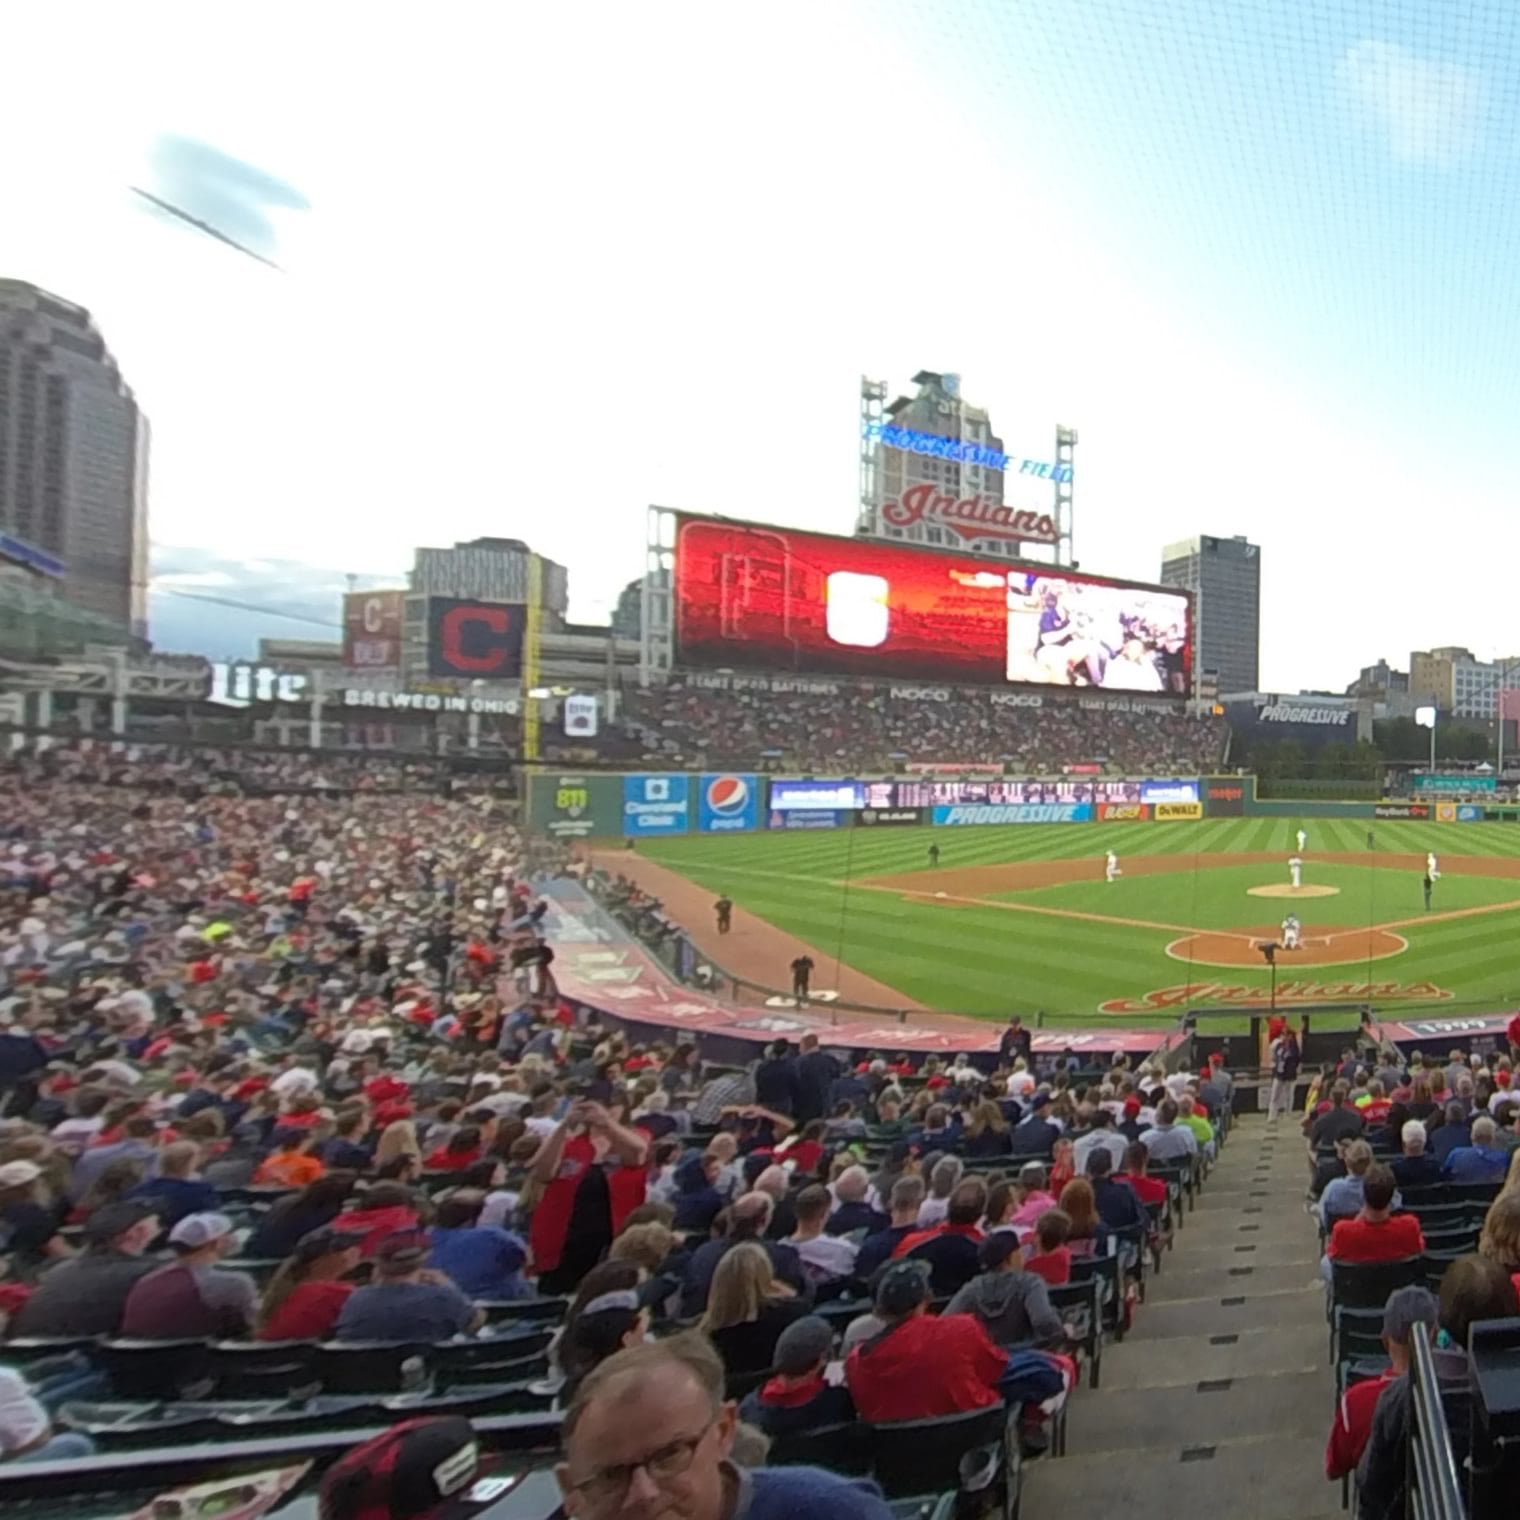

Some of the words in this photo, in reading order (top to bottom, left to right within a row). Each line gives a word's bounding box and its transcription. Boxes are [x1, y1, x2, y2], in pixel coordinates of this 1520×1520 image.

[864, 422, 1015, 471] PROGRESSIVE
[1019, 459, 1075, 484] FIELD
[881, 482, 1060, 544] Indians
[440, 605, 510, 672] C
[209, 662, 306, 709] Lite
[890, 687, 949, 702] NOCO
[344, 689, 441, 712] BREWED
[444, 695, 466, 713] IN
[470, 697, 520, 715] OHIO
[989, 694, 1043, 708] NOCO
[1259, 703, 1350, 726] PROGRESSIVE
[944, 804, 1076, 825] PROGRESSIVE
[1098, 981, 1455, 1014] Indians
